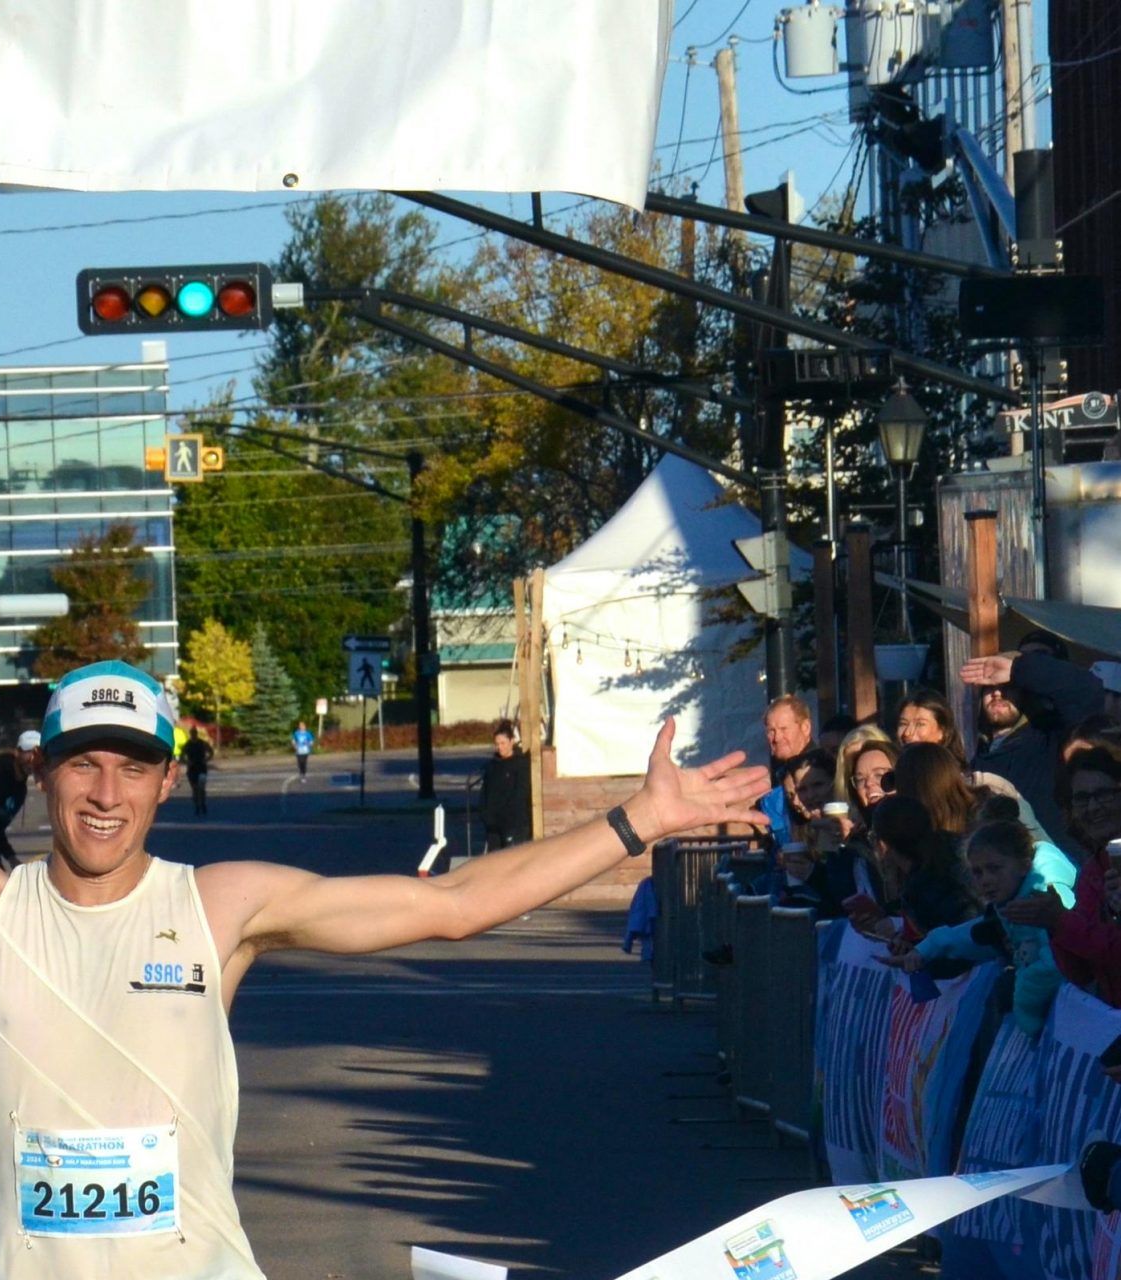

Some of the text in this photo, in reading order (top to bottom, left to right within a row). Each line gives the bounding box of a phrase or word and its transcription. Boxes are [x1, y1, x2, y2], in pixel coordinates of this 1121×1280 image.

[1013, 407, 1074, 432] KNT
[91, 689, 120, 701] SSAC
[143, 963, 183, 983] SSAC
[58, 1140, 125, 1152] MARATHON
[33, 1180, 160, 1219] 21216
